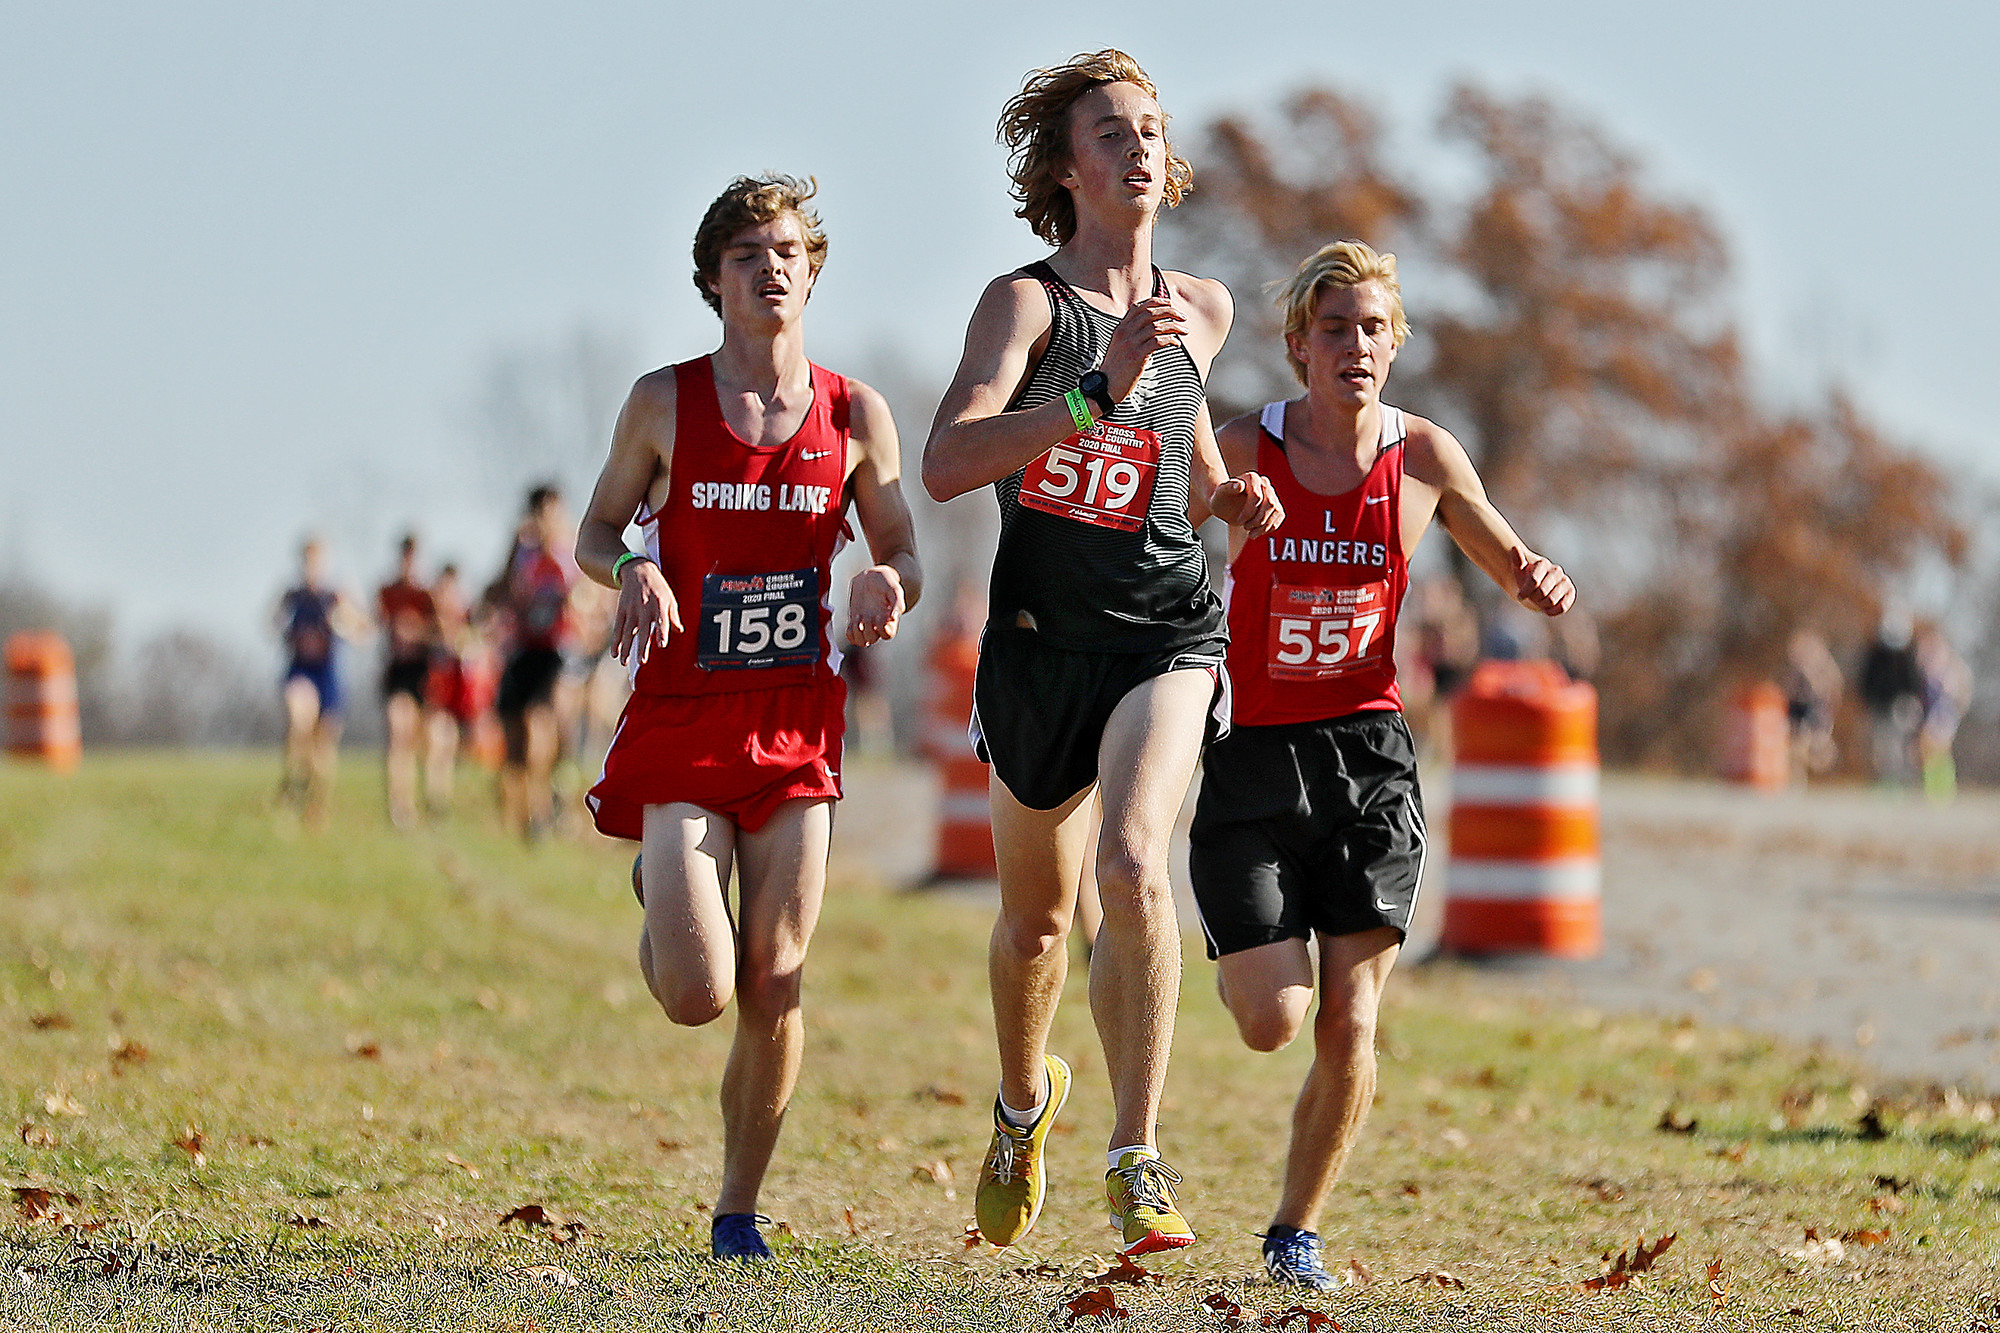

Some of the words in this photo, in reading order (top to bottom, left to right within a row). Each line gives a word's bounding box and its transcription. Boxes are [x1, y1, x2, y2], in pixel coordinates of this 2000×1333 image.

[1105, 434, 1145, 449] COUNTRY
[1107, 426, 1136, 439] CROSS
[1078, 438, 1100, 450] 2020
[1100, 442, 1122, 455] FINAL
[1038, 446, 1140, 510] 519
[691, 482, 771, 511] SPRING
[779, 483, 831, 514] LAKE
[1324, 510, 1336, 533] L
[1268, 537, 1386, 566] LANCERS
[742, 593, 762, 603] 2020
[763, 591, 785, 601] FINAL
[1311, 606, 1332, 615] 2020
[1333, 605, 1357, 614] FINAL
[713, 603, 806, 654] 158
[1276, 612, 1380, 665] 557
